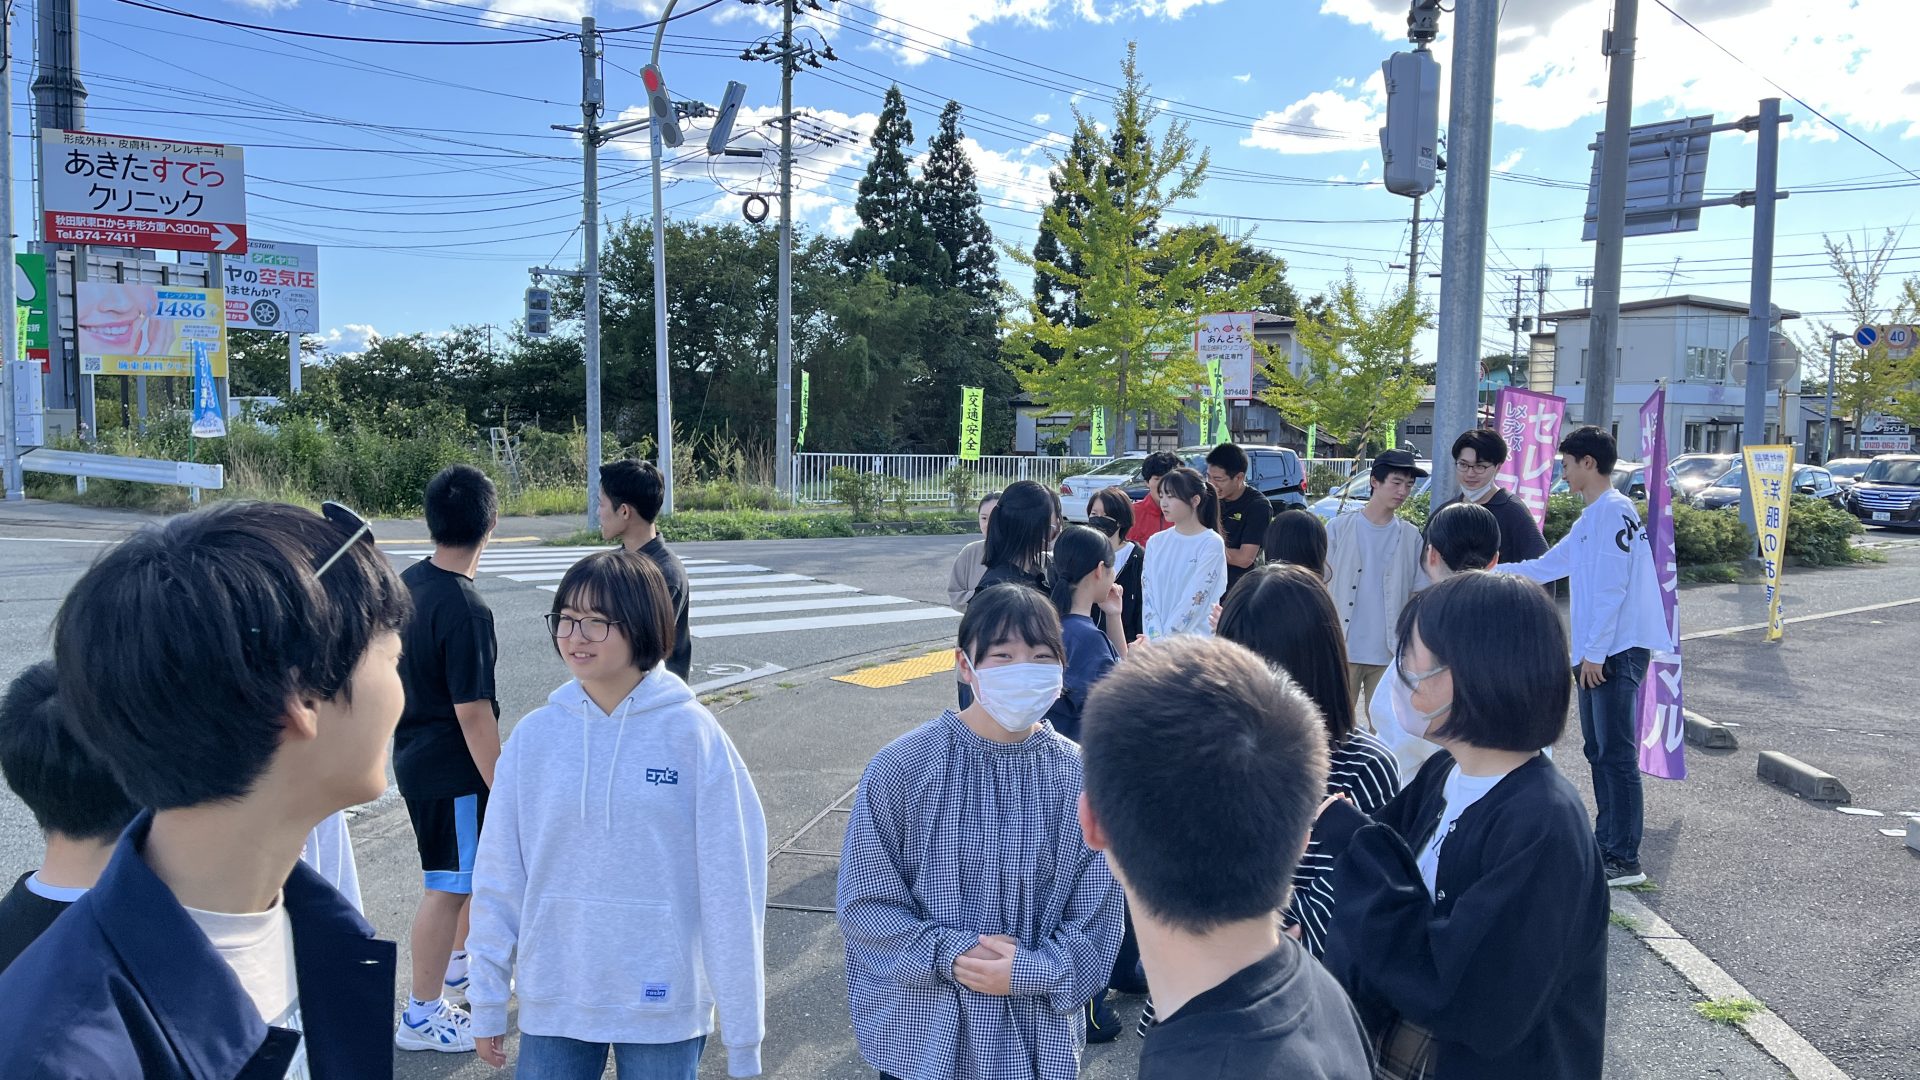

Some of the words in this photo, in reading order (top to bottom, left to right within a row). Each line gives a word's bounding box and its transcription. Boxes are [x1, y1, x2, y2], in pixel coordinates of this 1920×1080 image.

[63, 133, 225, 158] 形成外科・皮膚科・アレルギー科
[65, 148, 225, 187] あきたすてら
[89, 183, 204, 217] クリニック
[55, 214, 210, 236] 秋田駅東口から手形方面へ300m
[56, 229, 136, 243] Tel.874-7411
[224, 265, 315, 288] ヤの空気圧
[155, 301, 206, 318] 1486
[1207, 334, 1243, 343] あんどう
[1890, 330, 1906, 342] 40
[965, 392, 980, 451] 交通安全
